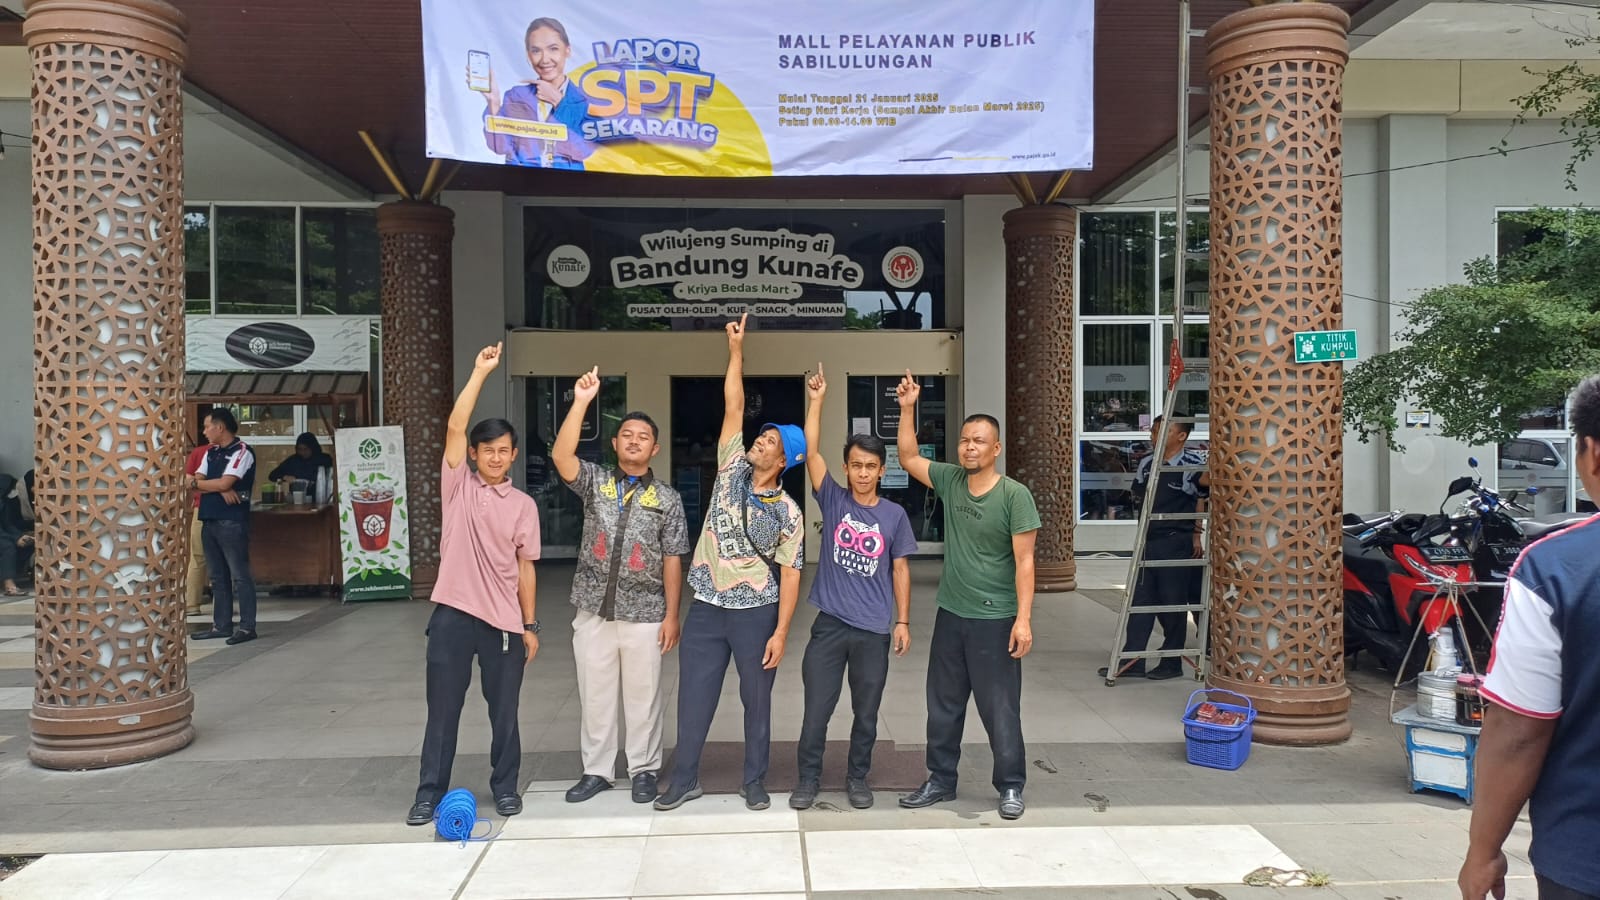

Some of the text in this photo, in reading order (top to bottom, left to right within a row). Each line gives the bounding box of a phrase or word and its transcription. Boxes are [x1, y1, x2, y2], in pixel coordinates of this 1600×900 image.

[778, 31, 1035, 49] MALL PELAYANAN PUBLIK
[593, 39, 699, 68] LAPOR
[778, 54, 933, 69] SABILULUNGAN
[581, 69, 713, 119] SPT
[779, 94, 807, 103] Mulai
[810, 94, 852, 105] Tanggal
[855, 94, 867, 103] 21
[871, 94, 911, 103] Januari
[779, 106, 812, 116] Setiap
[815, 106, 838, 115] Hari
[841, 105, 869, 116] Kerja
[873, 105, 915, 116] (Sampai
[918, 105, 946, 114] Akhir
[949, 104, 979, 113] Bulan
[983, 102, 1013, 111] Maret
[495, 122, 558, 135] www.pajak.go.id
[779, 118, 809, 127] Pukul
[876, 117, 897, 126] WIB
[581, 118, 717, 143] SEKARANG
[646, 233, 829, 253] Wilujeng Sumping di
[616, 255, 748, 282] Bandung
[758, 255, 858, 283] Kunafe
[687, 283, 790, 295] Kriya Bedas Mart
[630, 306, 843, 314] PUSAT OLEH-OLEH KUE SNACK MINUMAN
[1326, 333, 1347, 343] TITIK
[1320, 342, 1354, 352] KUMPUL
